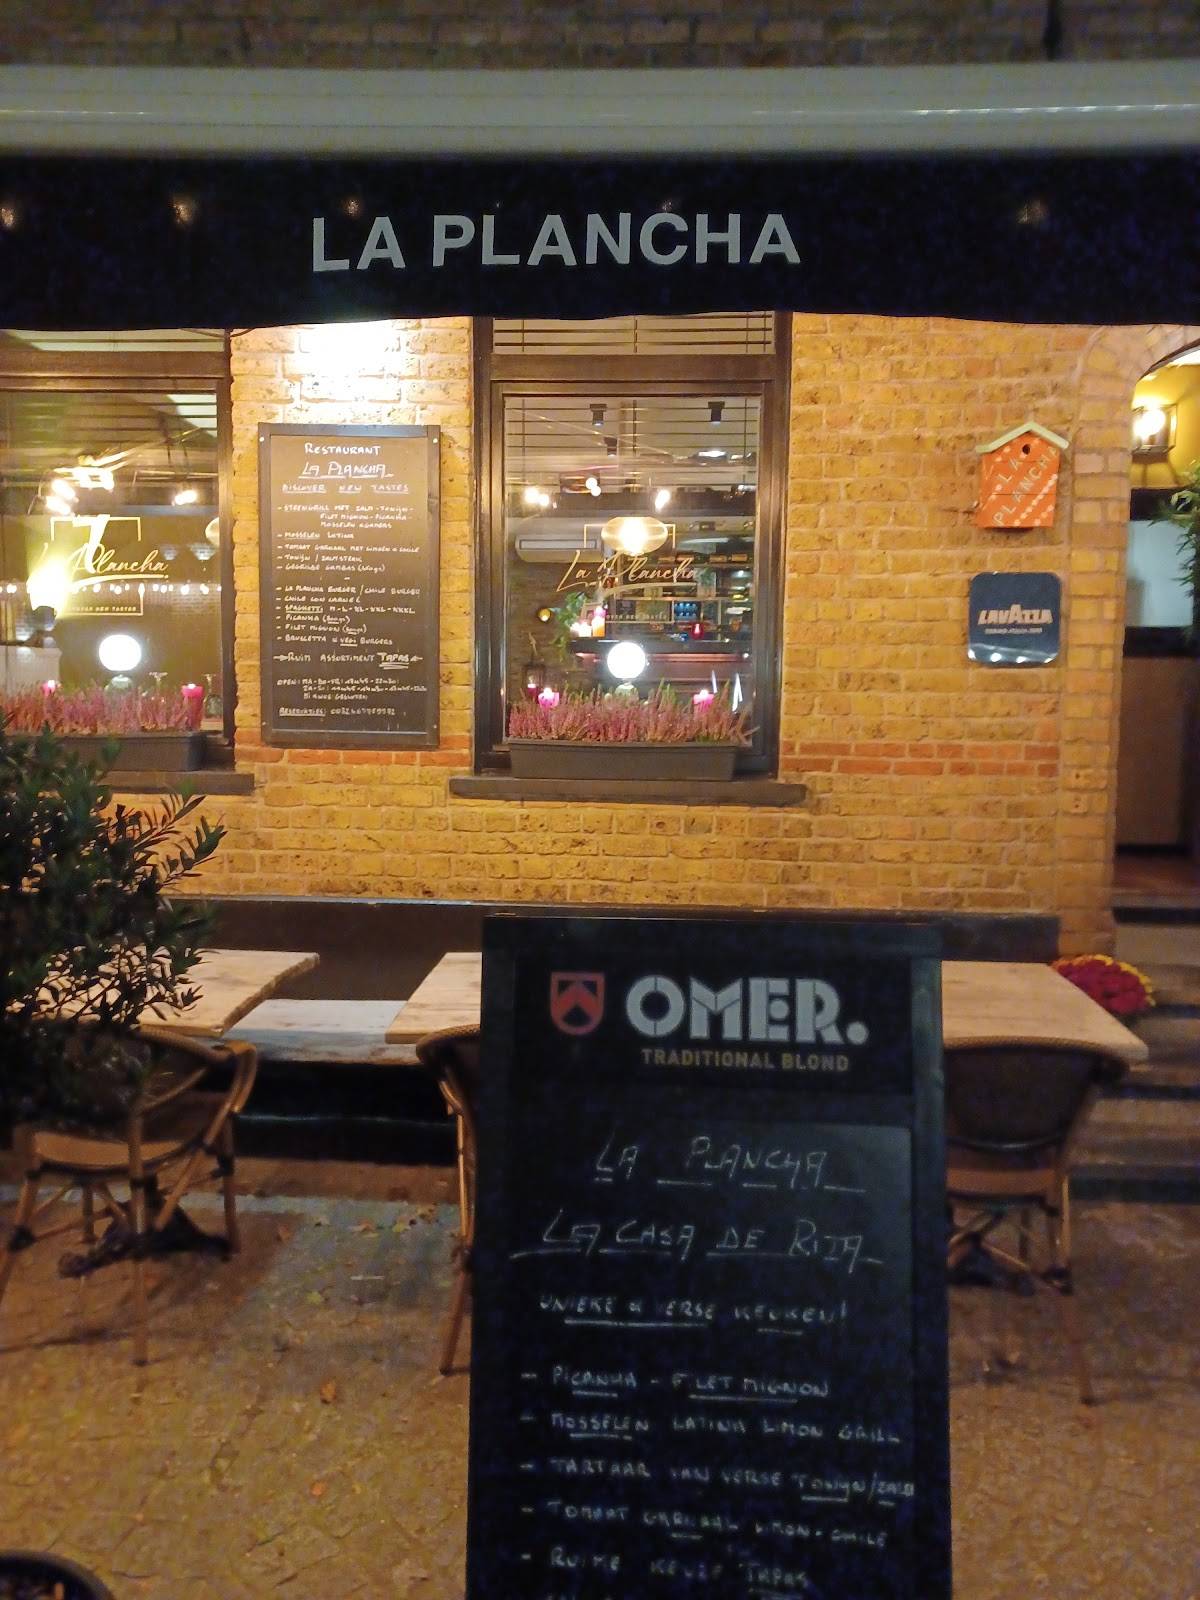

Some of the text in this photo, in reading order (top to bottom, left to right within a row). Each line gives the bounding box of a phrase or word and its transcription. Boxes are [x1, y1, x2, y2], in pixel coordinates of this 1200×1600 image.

[311, 211, 801, 272] LA PLANCHA
[302, 460, 387, 478] LA PLANCHA
[640, 1048, 849, 1072] TRADITIONAL BLOND
[595, 1130, 828, 1190] LA PLANCHA
[716, 1229, 767, 1250] DE
